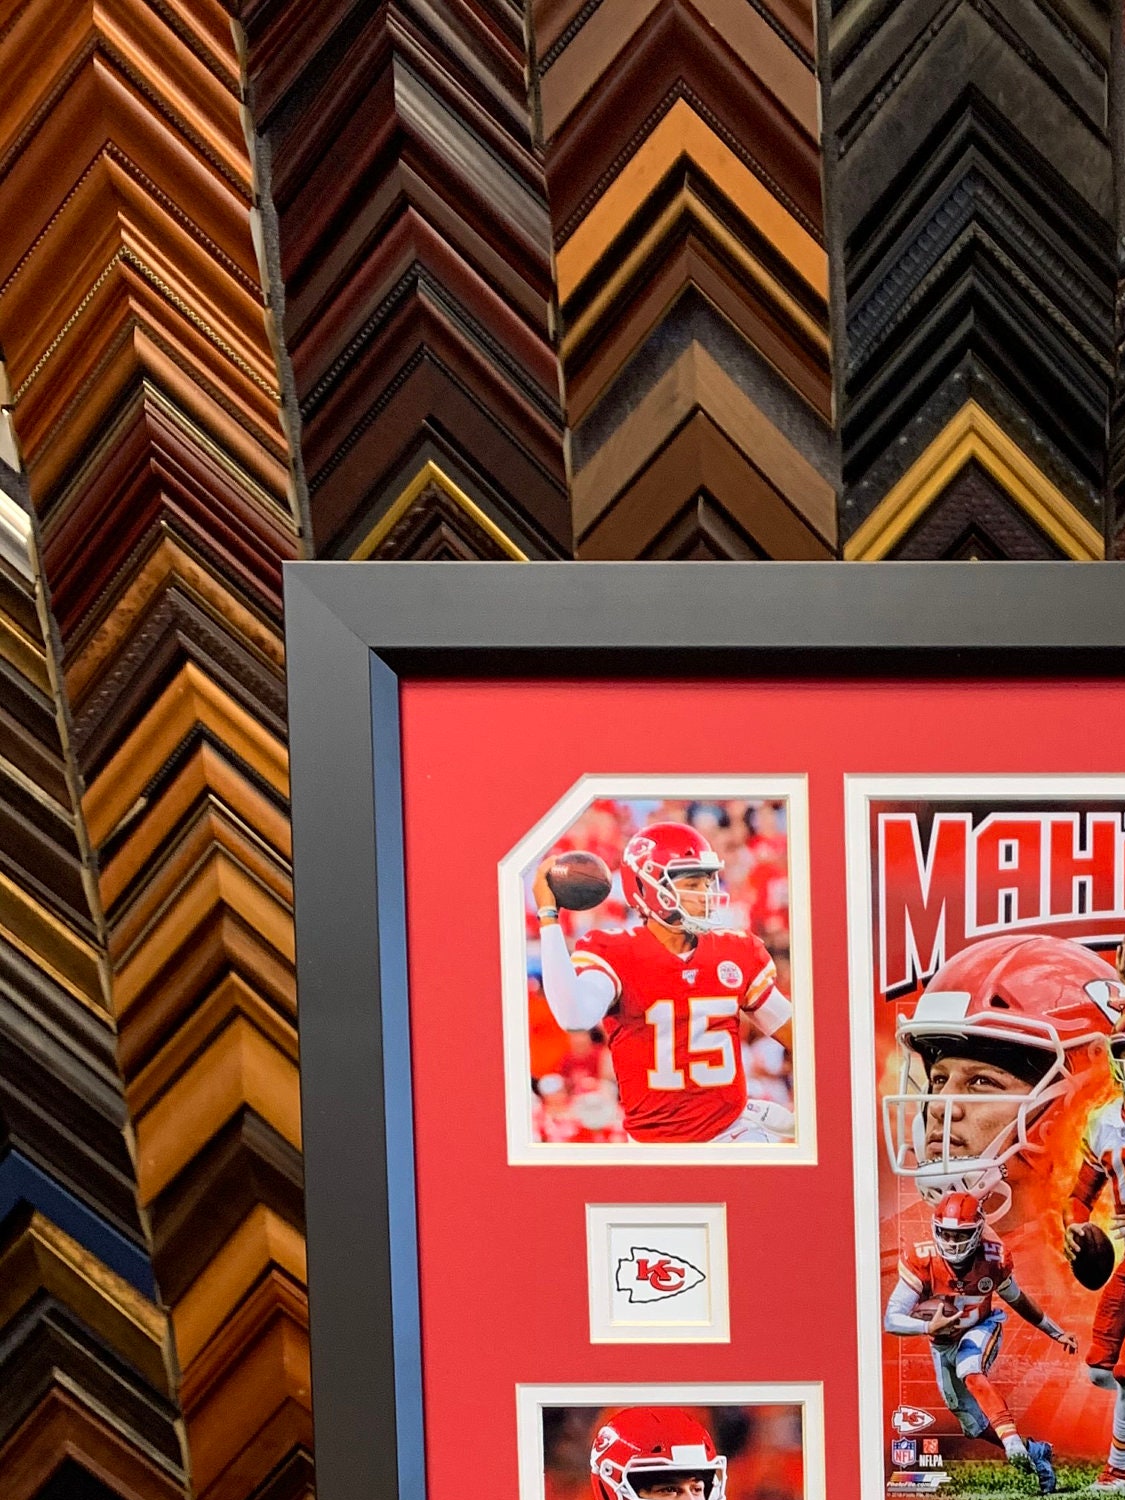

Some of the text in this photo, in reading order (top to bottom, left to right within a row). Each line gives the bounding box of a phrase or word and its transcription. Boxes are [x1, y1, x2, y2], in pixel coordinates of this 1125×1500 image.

[645, 996, 738, 1091] 15
[636, 1259, 685, 1292] KC
[895, 1450, 914, 1461] NFL
[919, 1454, 943, 1467] NFLPA
